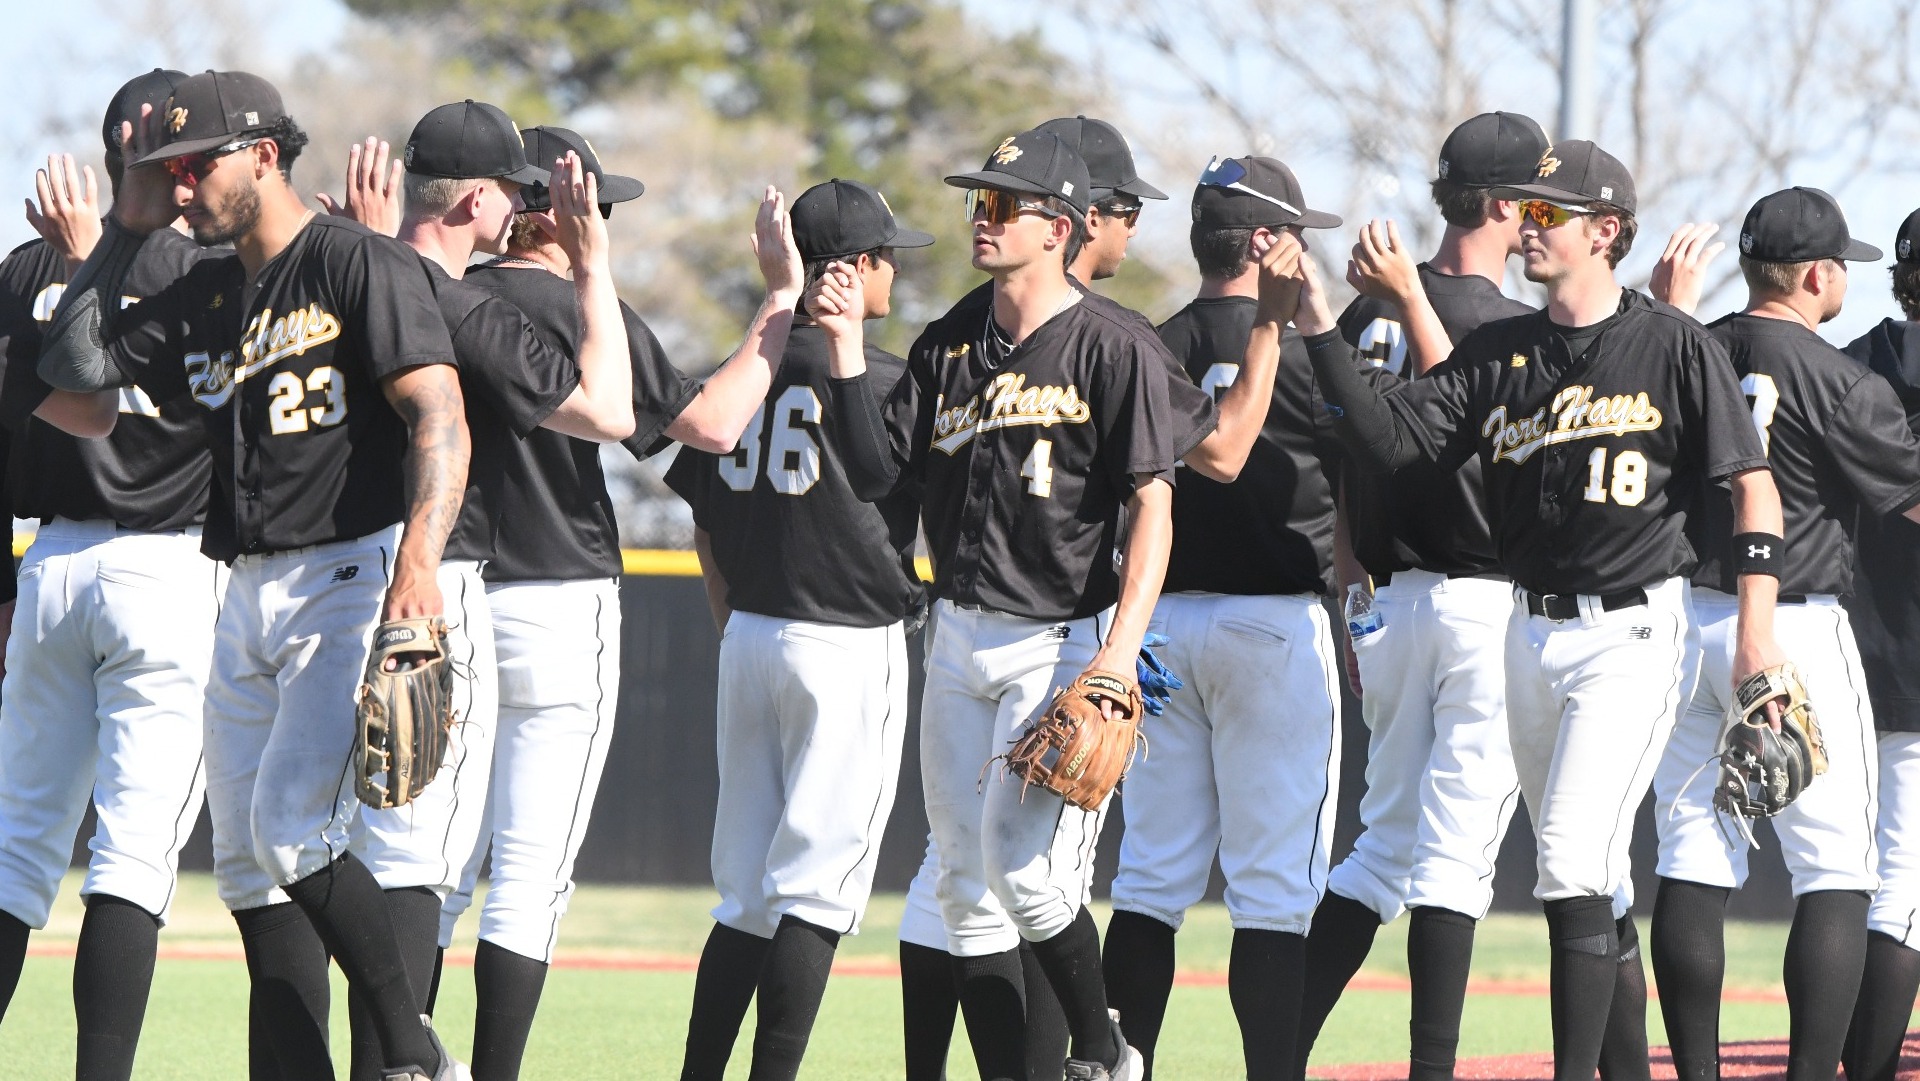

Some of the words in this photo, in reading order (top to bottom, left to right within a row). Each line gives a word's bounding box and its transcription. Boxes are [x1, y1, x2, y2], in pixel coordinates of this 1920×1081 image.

[239, 302, 341, 356] Hays
[268, 365, 348, 436] 23
[983, 373, 1090, 428] Hays
[1481, 405, 1547, 464] Fort
[1551, 384, 1663, 437] Hays
[718, 384, 823, 496] 36
[1020, 438, 1053, 498] 4
[1583, 446, 1649, 507] 18
[1085, 676, 1125, 695] Wilson
[1065, 741, 1091, 778] A2000
